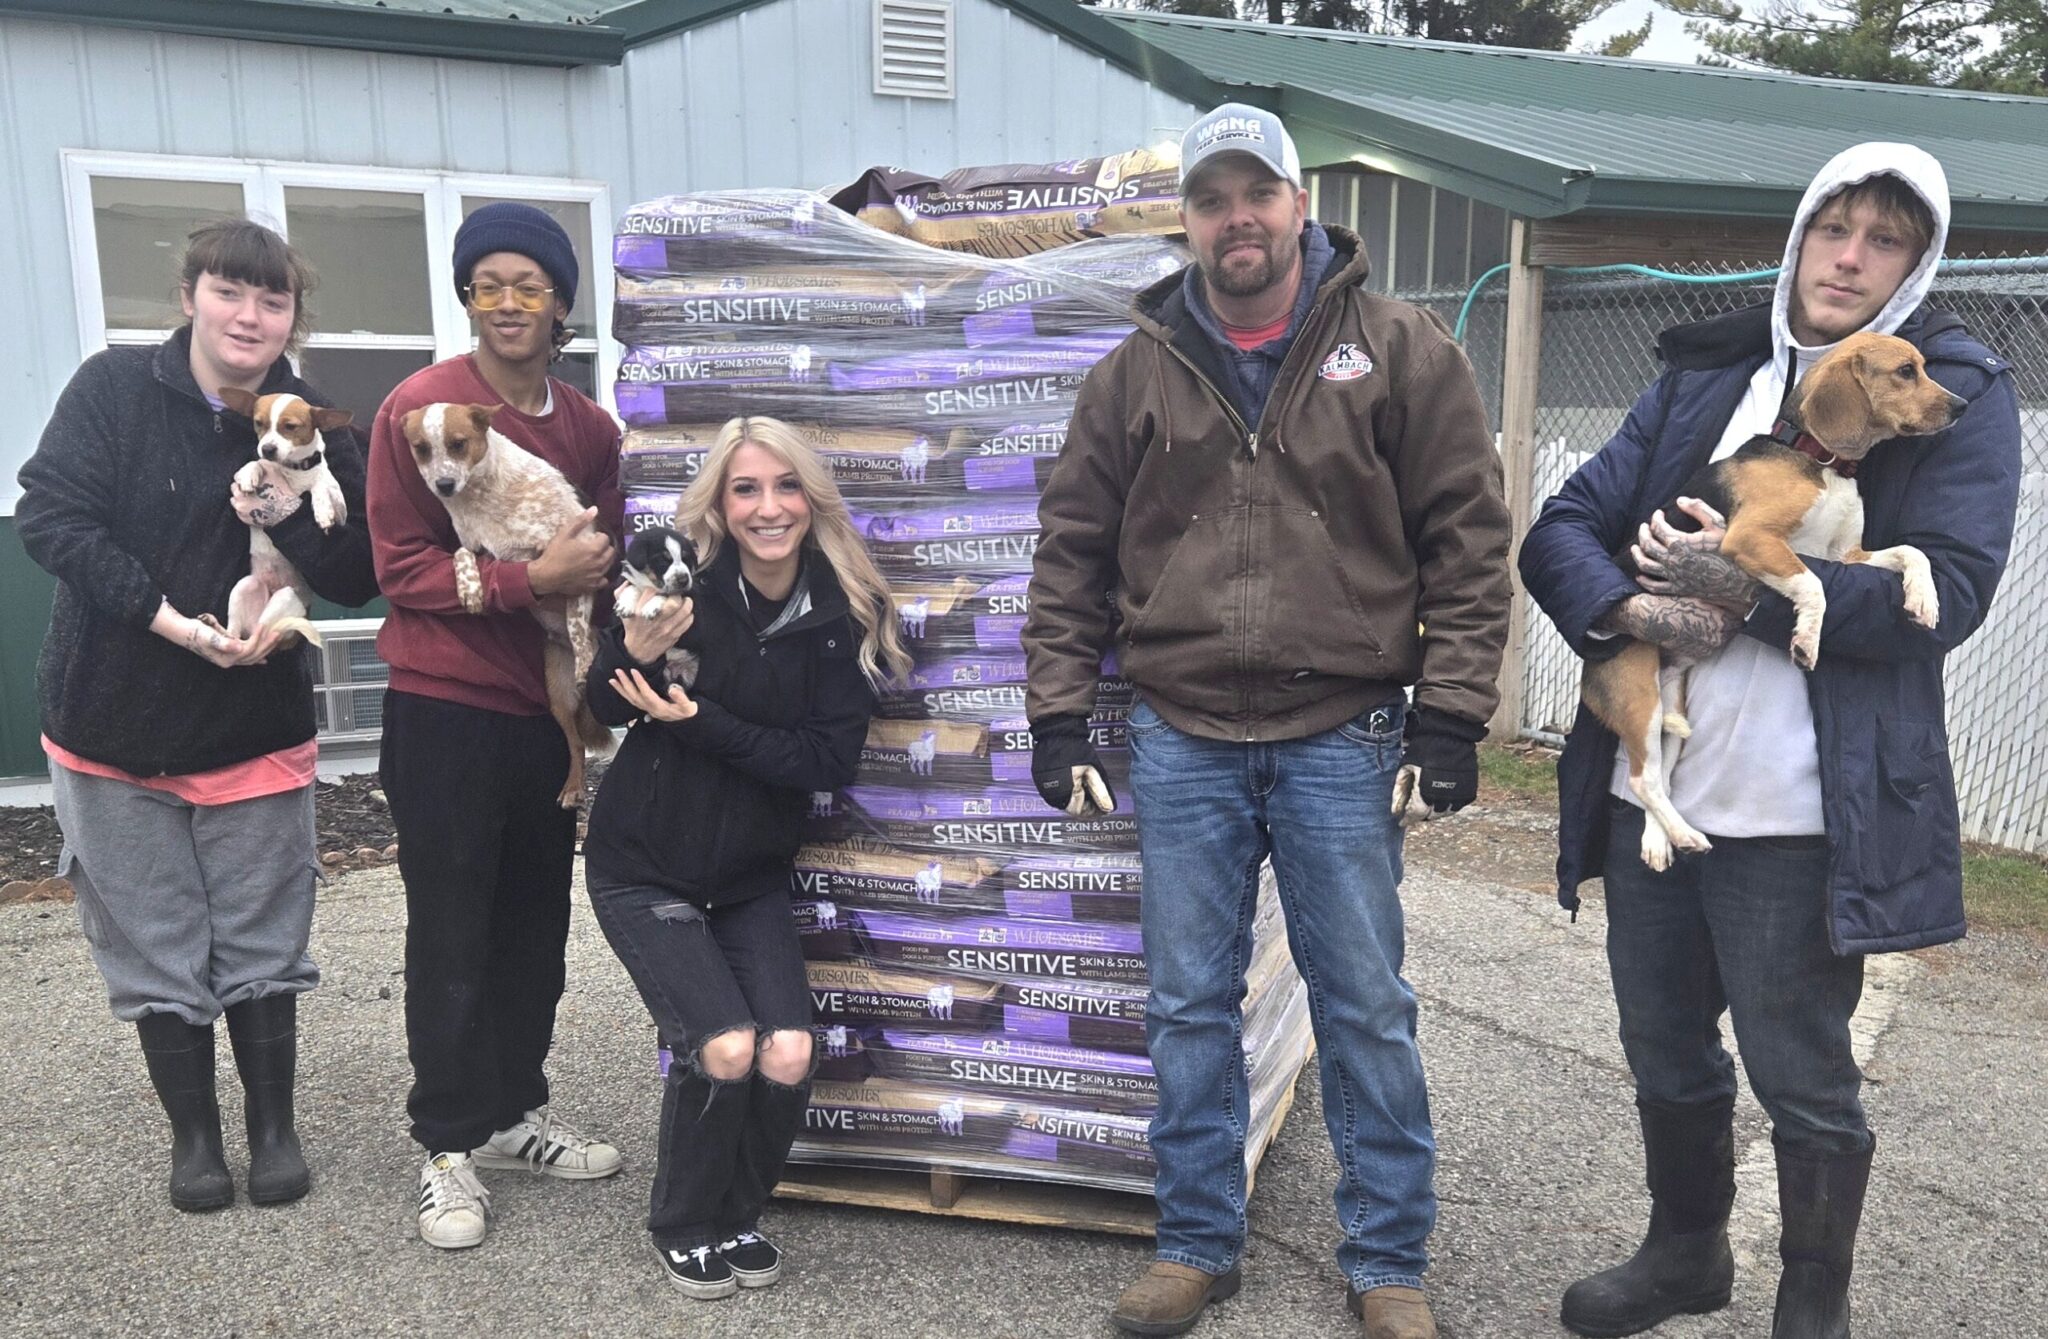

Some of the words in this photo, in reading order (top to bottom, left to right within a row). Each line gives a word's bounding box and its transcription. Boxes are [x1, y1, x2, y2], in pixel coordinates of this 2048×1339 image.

[1197, 117, 1261, 142] WANA
[1007, 179, 1140, 210] SENSITIVE
[965, 201, 974, 211] &
[976, 201, 1004, 211] SKIN
[623, 216, 712, 234] SENSITIVE
[975, 281, 1052, 311] SENSITI
[683, 298, 811, 323] SENSITIVE
[814, 300, 840, 310] SKIN
[842, 301, 848, 310] &
[850, 302, 905, 314] STOMACH
[1338, 345, 1356, 360] K
[714, 358, 734, 368] SKIN
[736, 358, 744, 367] &
[745, 357, 792, 368] STOMACH
[1319, 362, 1369, 377] KALMBACH
[925, 377, 1059, 415] SENSITIVE
[980, 432, 1067, 456] SENSITIV
[840, 457, 850, 468] &
[850, 458, 902, 471] STOMACH
[860, 750, 911, 764] STOMACH
[1432, 781, 1456, 789] KINCO
[933, 822, 1063, 844] SENSITIVE
[1066, 822, 1090, 832] SKIN
[1092, 821, 1100, 830] &
[1103, 820, 1136, 830] STOM
[1068, 835, 1088, 843] WITH
[1090, 834, 1113, 842] LAMB
[1114, 833, 1138, 841] PROTE
[832, 876, 855, 886] SKIN
[857, 878, 864, 888] &
[867, 879, 918, 892] STOMACH
[1018, 872, 1122, 891] SENSITIVE
[1126, 874, 1142, 883] SKI
[792, 906, 818, 916] MACH
[948, 950, 1076, 976] SENSITIVE
[1080, 957, 1104, 968] SKIN
[1106, 958, 1116, 968] &
[1118, 958, 1147, 969] STOM
[808, 968, 869, 984] OLESOMES
[846, 994, 870, 1004] SKIN
[870, 996, 879, 1004] &
[881, 998, 930, 1008] STOMACH
[1018, 988, 1120, 1016] SENSITIVE
[1124, 1002, 1147, 1011] SKIN
[950, 1060, 1076, 1092] SENSITIVE
[1080, 1074, 1104, 1085] SKIN
[1106, 1077, 1115, 1086] &
[1116, 1078, 1159, 1091] STOMAC
[857, 1112, 880, 1122] SKIN
[882, 1113, 889, 1122] &
[891, 1114, 941, 1125] STOMACH
[1112, 1128, 1134, 1140] SKIN
[1134, 1132, 1142, 1142] &
